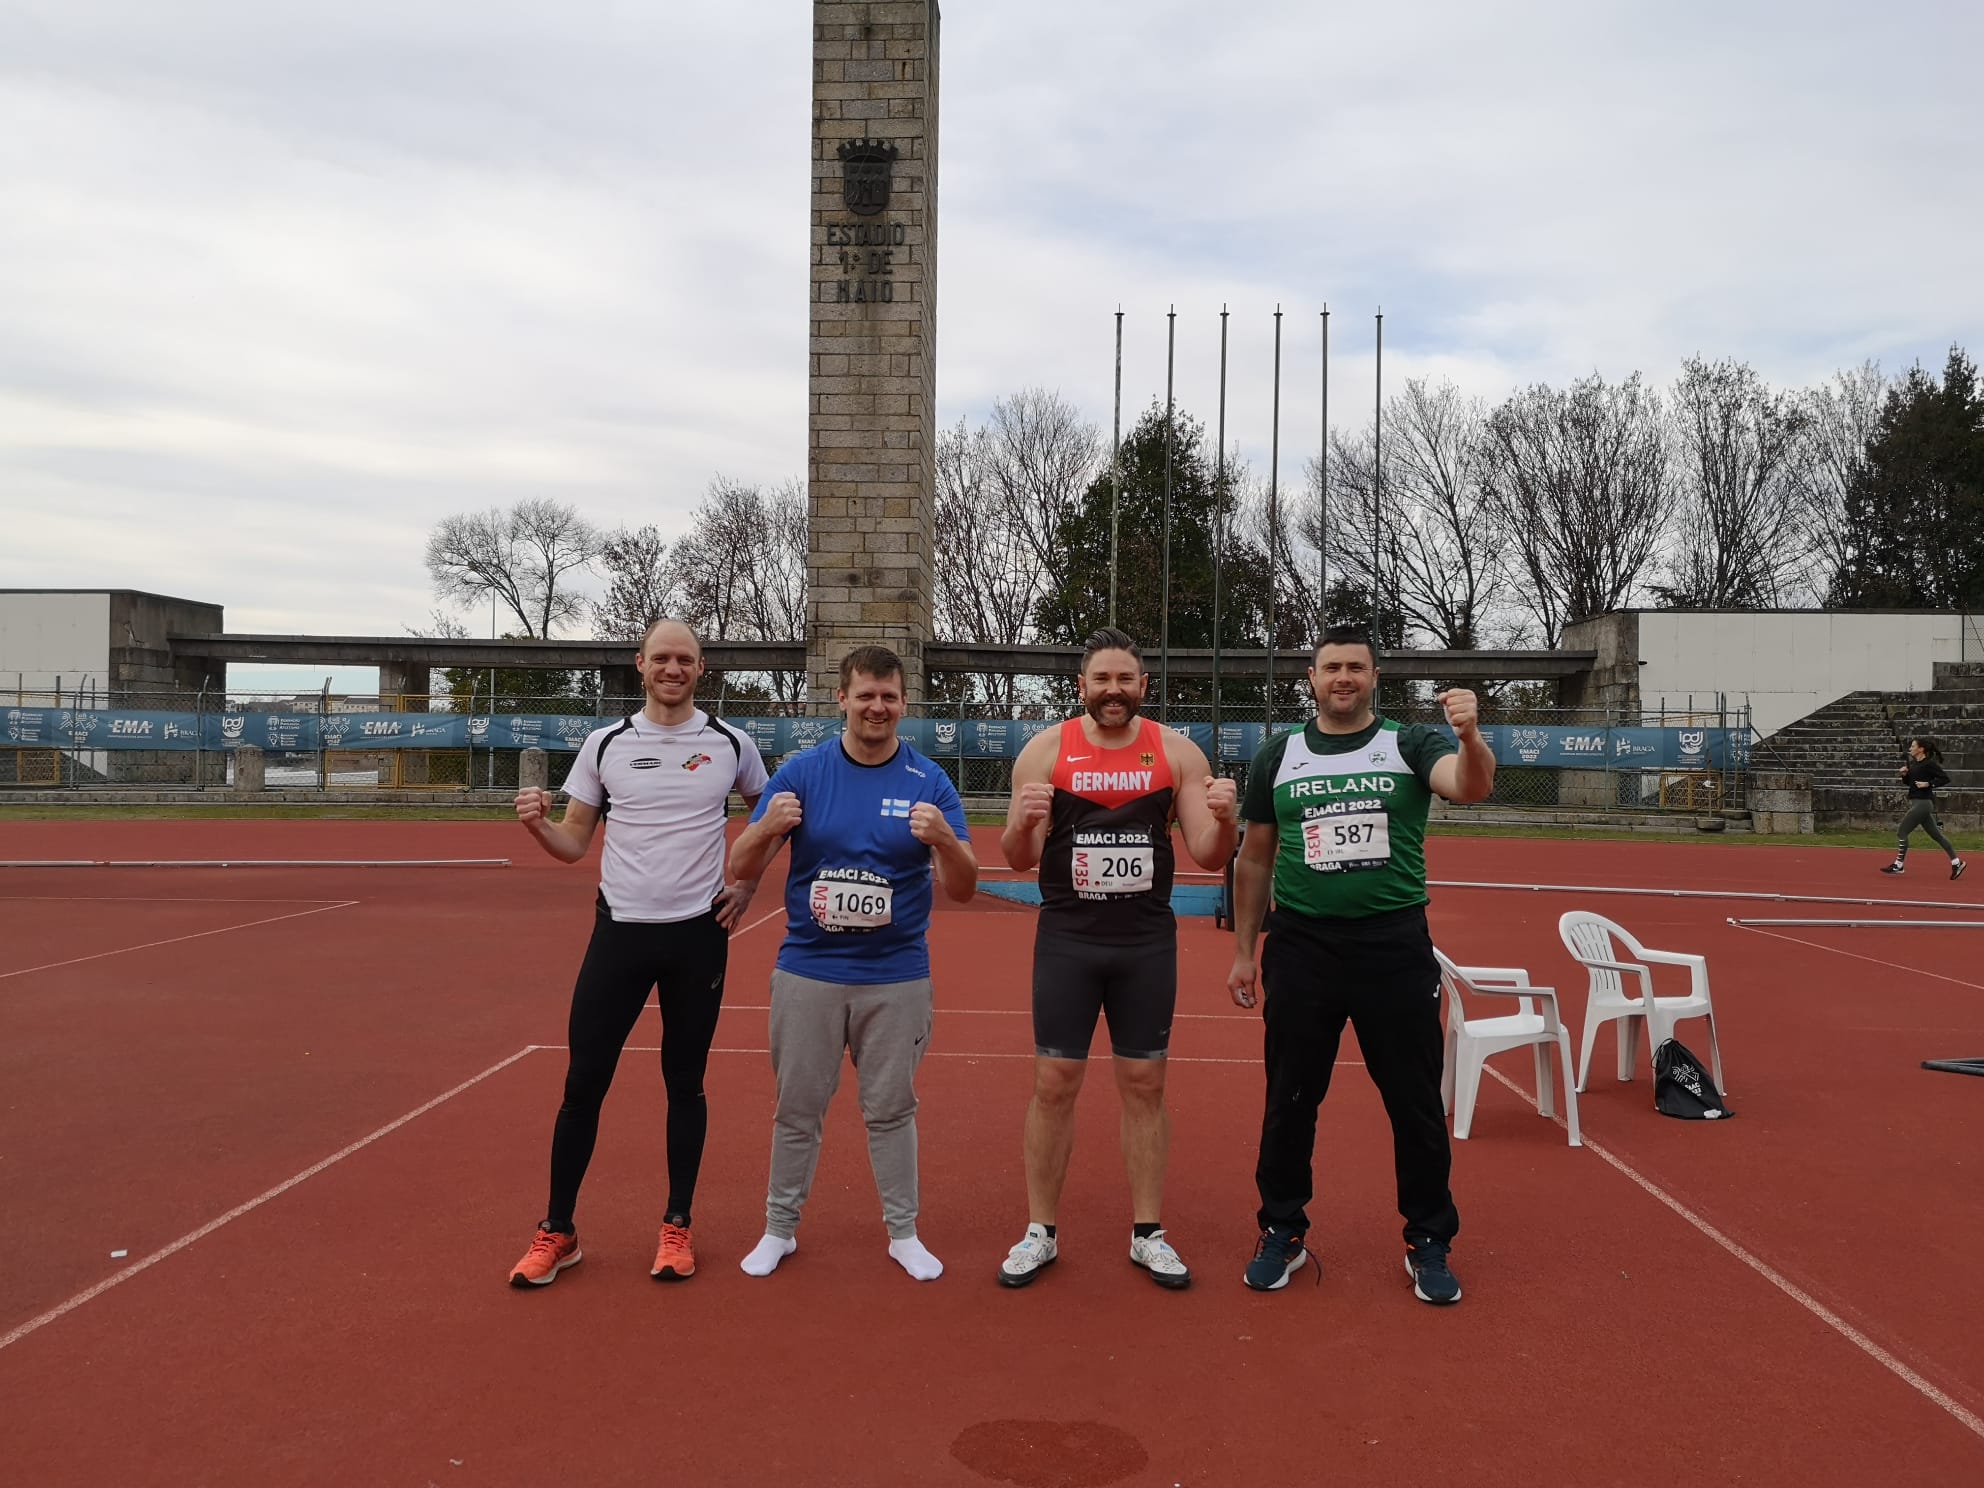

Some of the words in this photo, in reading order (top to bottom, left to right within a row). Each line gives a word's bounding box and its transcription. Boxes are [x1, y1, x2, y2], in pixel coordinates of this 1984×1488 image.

[868, 250, 893, 275] DE
[837, 280, 893, 303] MAIO
[111, 720, 151, 734] EMA
[363, 722, 401, 734] EMA
[1563, 737, 1603, 751] EMA
[1679, 731, 1704, 746] ipdj
[1072, 771, 1152, 792] GERMANY
[1290, 777, 1395, 798] IRELAND
[1305, 802, 1345, 818] EMACI
[1349, 800, 1382, 811] 2022
[1076, 833, 1115, 844] EMACI
[1119, 834, 1150, 844] 2022
[1305, 825, 1320, 858] M35
[1334, 824, 1374, 846] 587
[819, 868, 858, 881] EMACI
[860, 871, 889, 885] 2022
[1075, 853, 1088, 886] M35
[1102, 858, 1142, 877] 206
[813, 885, 829, 920] M35
[835, 893, 886, 915] 1069
[1078, 891, 1107, 901] BRAGA
